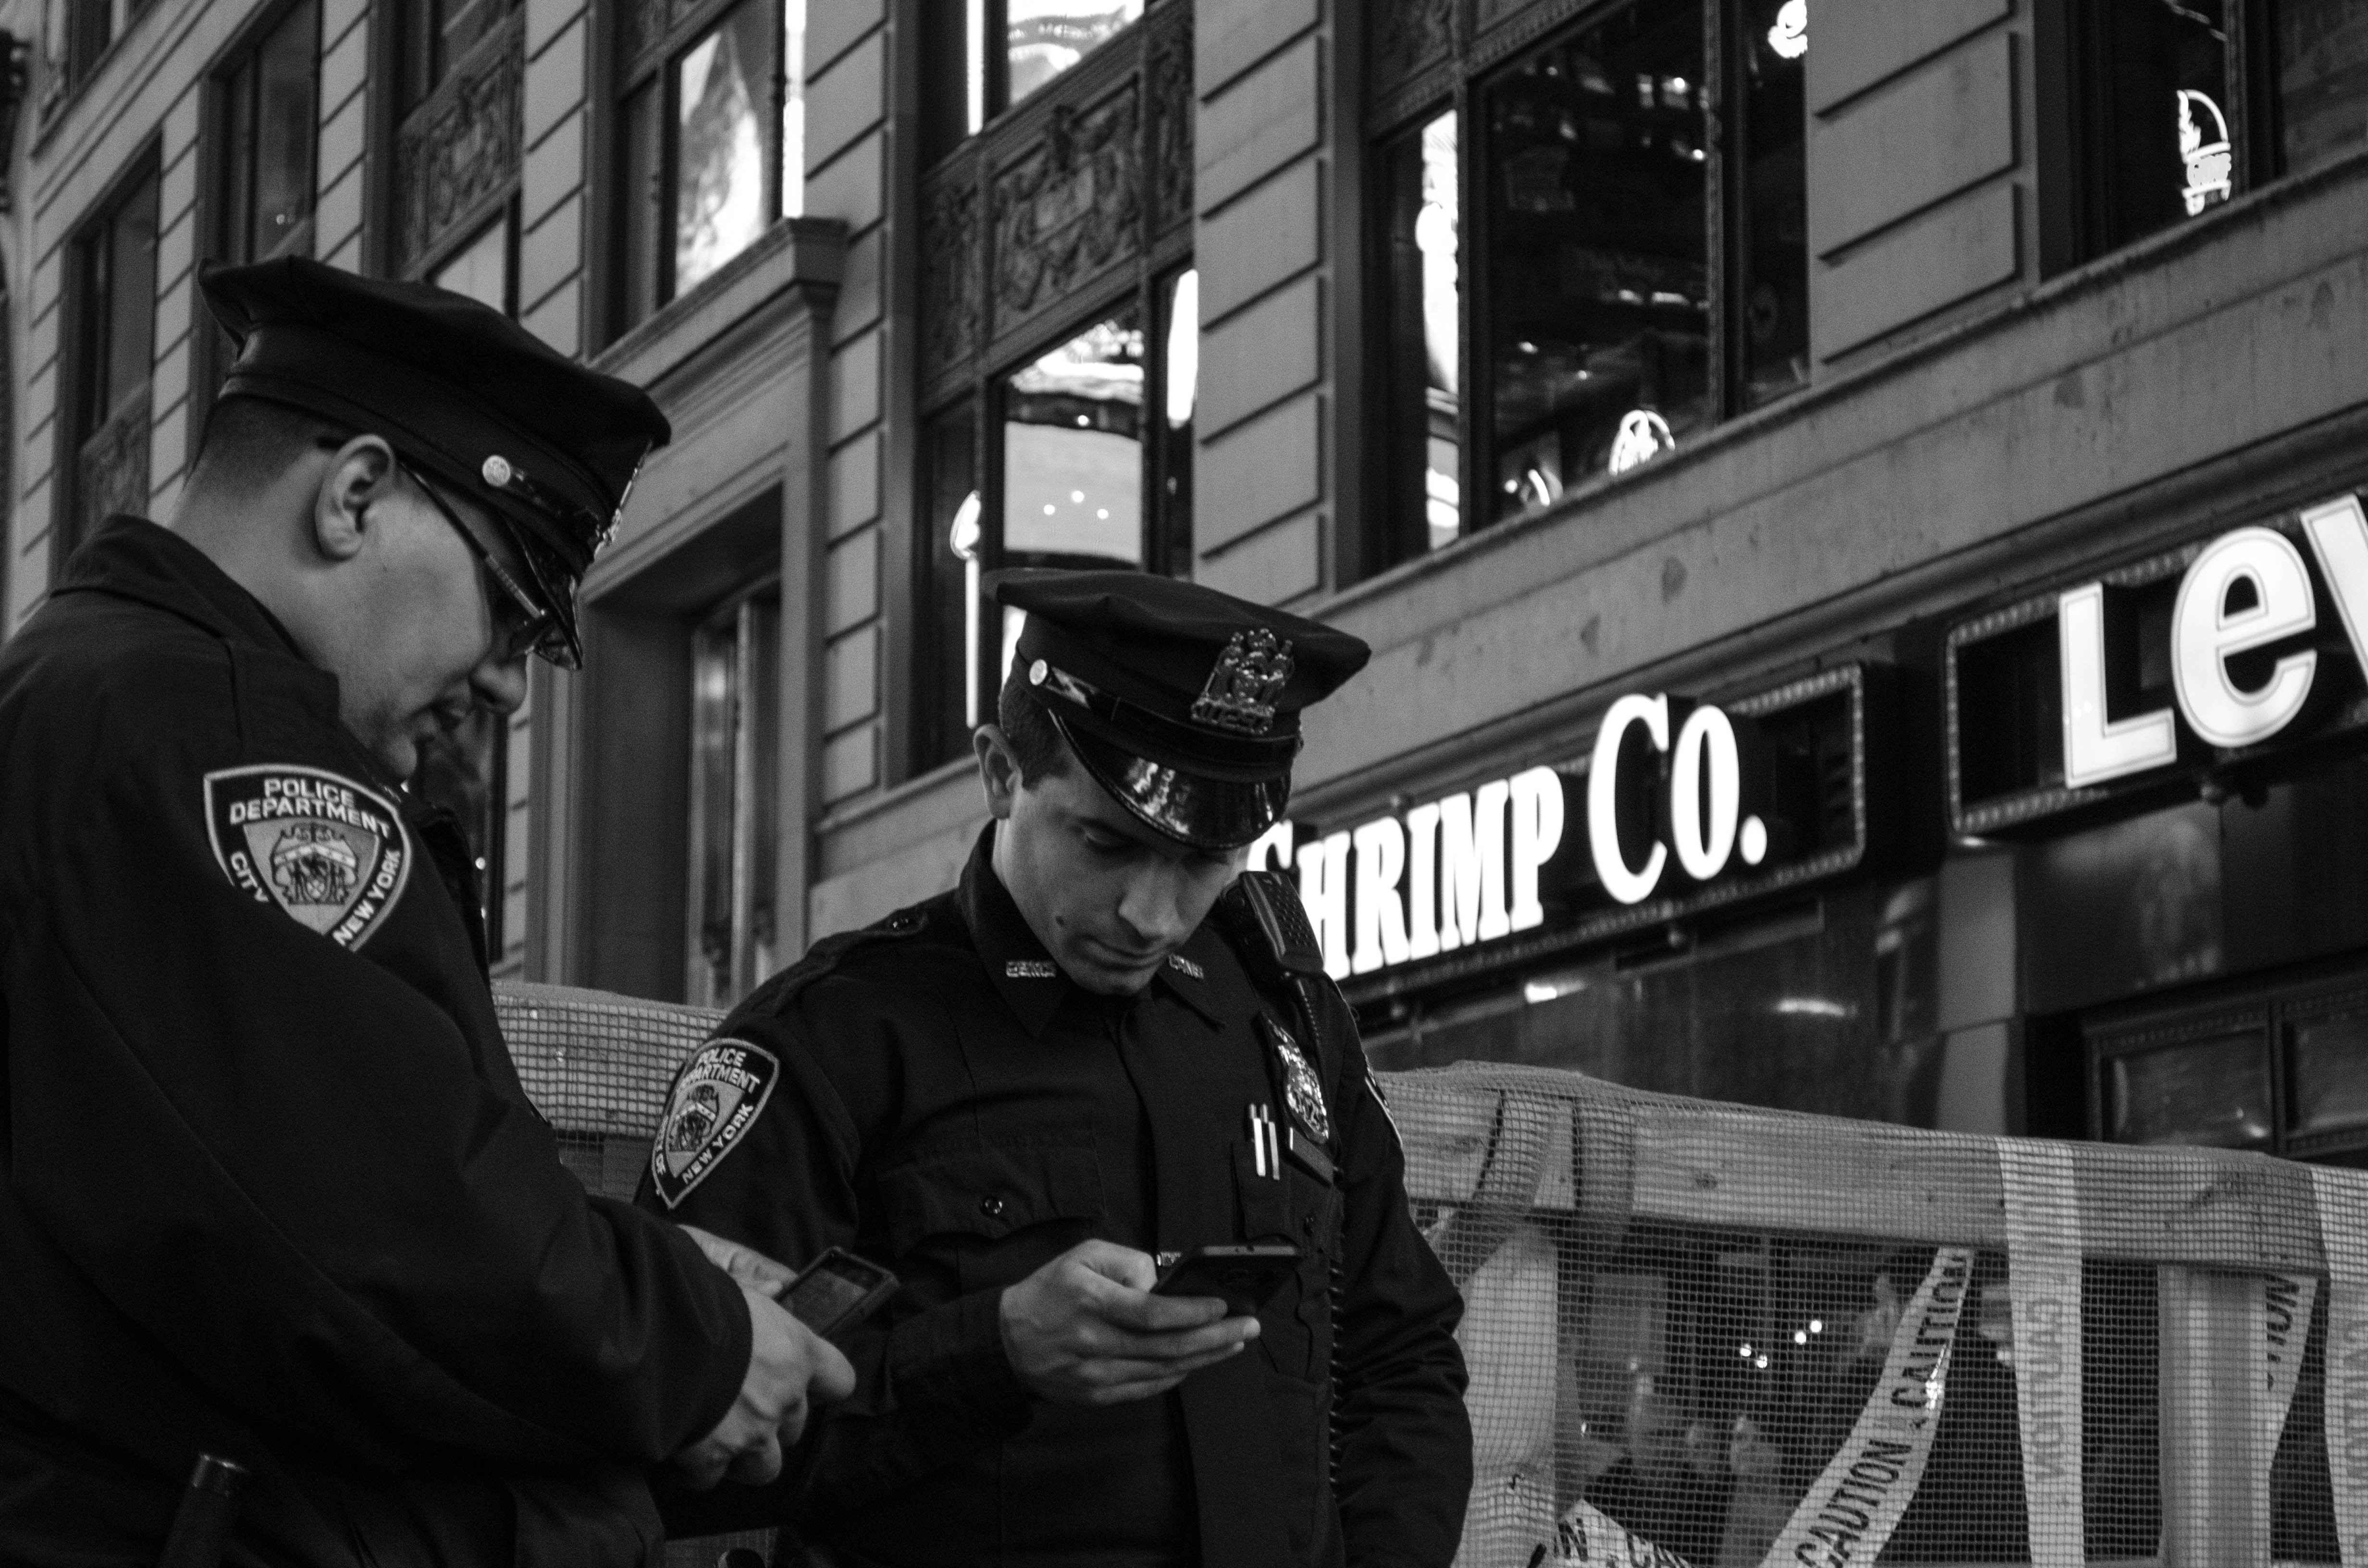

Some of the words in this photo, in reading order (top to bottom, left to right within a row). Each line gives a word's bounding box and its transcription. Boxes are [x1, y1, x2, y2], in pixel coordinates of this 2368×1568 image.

[229, 796, 391, 839] DEPARTMENT
[264, 778, 355, 808] POLICE
[230, 851, 269, 903] CITY
[332, 900, 375, 946] NEW
[367, 849, 401, 900] YORK
[682, 1148, 713, 1184] NEW
[711, 1103, 754, 1149] YORK
[1795, 1439, 1912, 1568] CAUTION
